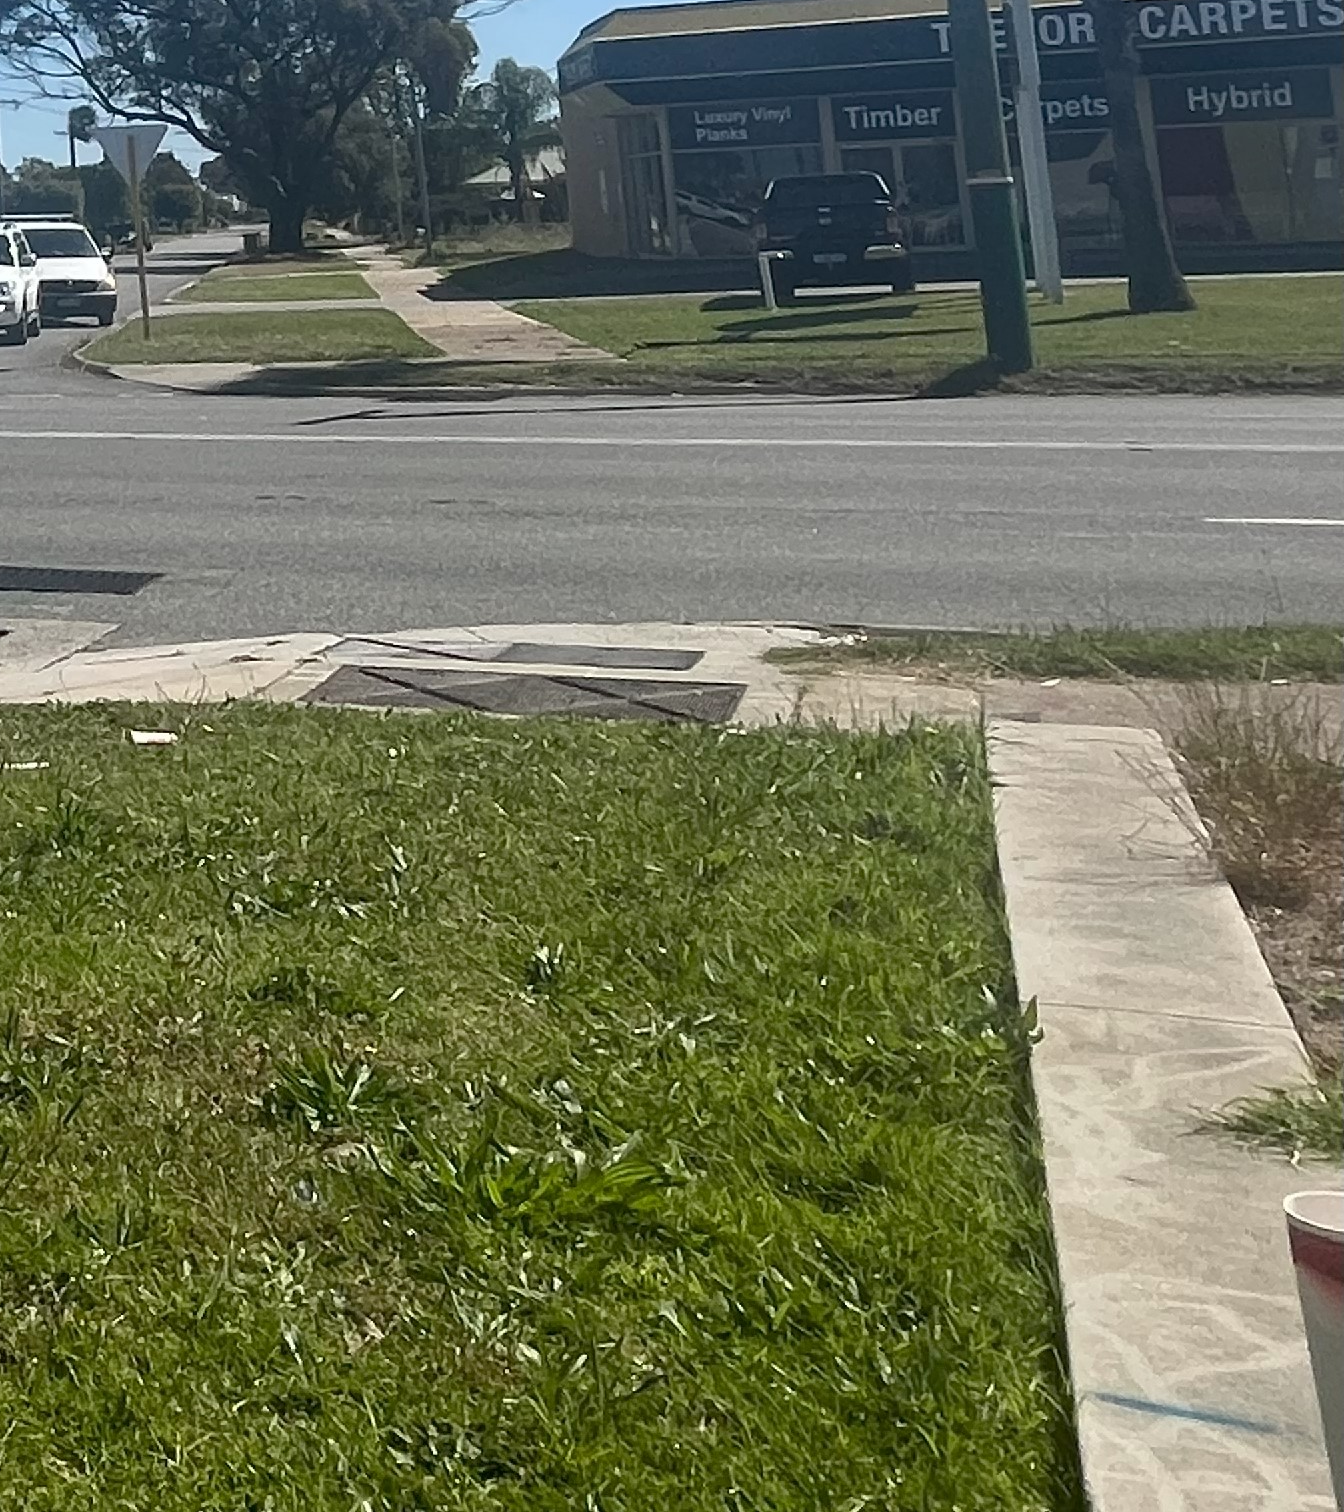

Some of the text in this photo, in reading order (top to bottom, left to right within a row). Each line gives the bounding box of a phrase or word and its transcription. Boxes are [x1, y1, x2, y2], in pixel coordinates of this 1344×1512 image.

[930, 12, 1097, 53] TEOR
[1186, 81, 1293, 116] Hybrid
[694, 105, 792, 125] Luxury Vinyl
[843, 104, 942, 129] Timber
[696, 127, 748, 142] Planks
